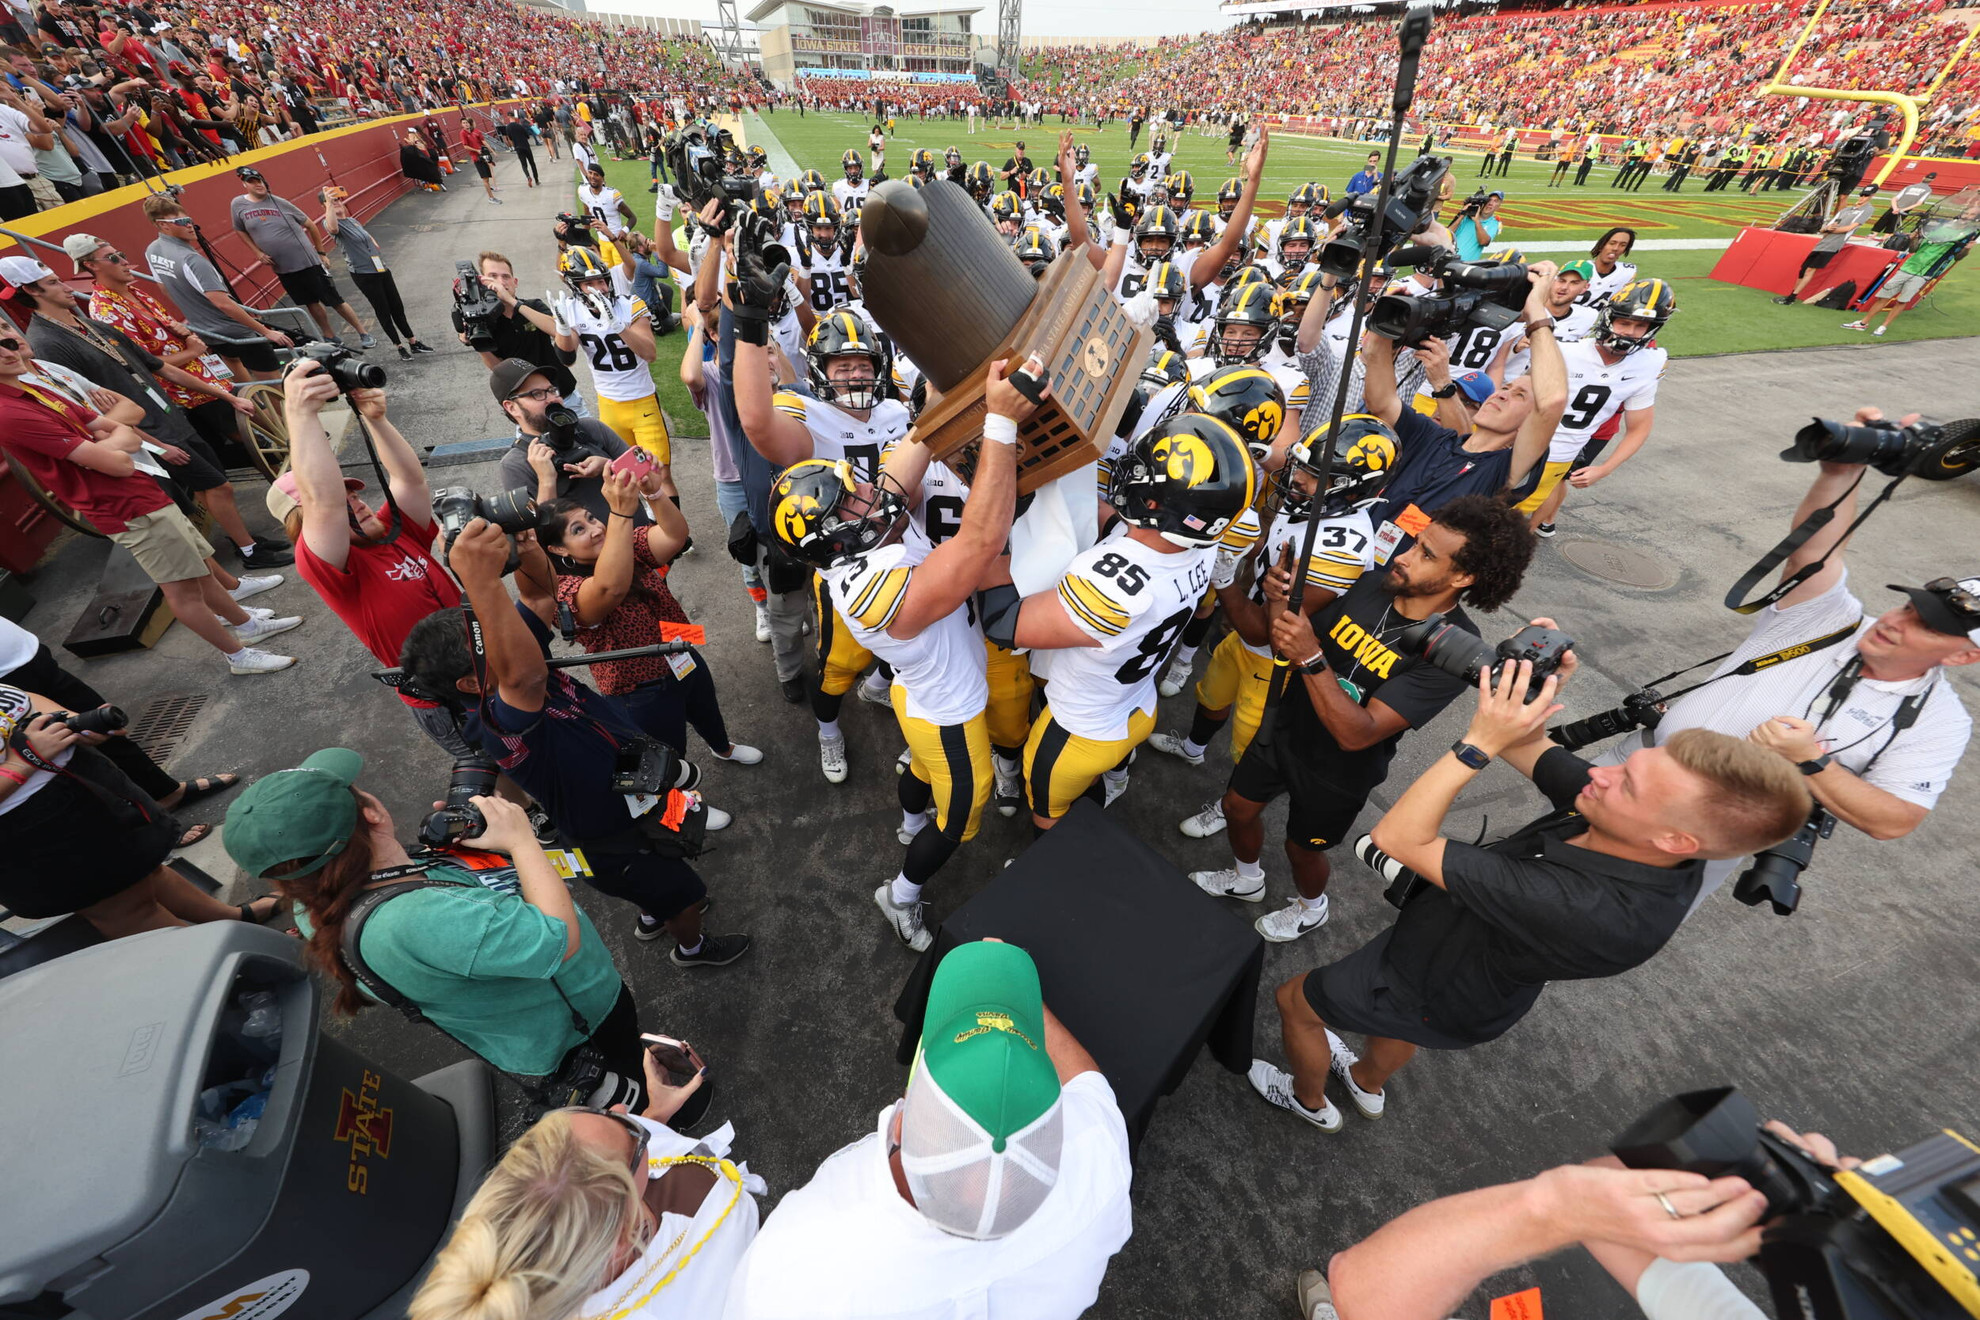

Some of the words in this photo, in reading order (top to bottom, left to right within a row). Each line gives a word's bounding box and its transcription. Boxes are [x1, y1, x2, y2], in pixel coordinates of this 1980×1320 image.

[795, 40, 823, 51] IOWA
[826, 41, 860, 52] STATE
[905, 45, 966, 57] CYCLONES
[1151, 165, 1159, 179] 2
[244, 209, 283, 221] CYCLONES
[150, 254, 176, 270] BEST
[811, 272, 849, 312] 85
[580, 333, 638, 372] 26
[1449, 328, 1502, 369] 18
[1560, 384, 1612, 430] 9
[1323, 526, 1367, 553] 37
[1092, 552, 1151, 597] 85
[1173, 579, 1189, 604] L.
[1188, 558, 1209, 594] LEE
[472, 620, 485, 656] Canon
[1114, 606, 1194, 684] 8
[1329, 614, 1402, 680] IOWA
[1779, 645, 1811, 661] D500
[23, 748, 41, 769] EOS
[346, 1069, 381, 1195] STATE
